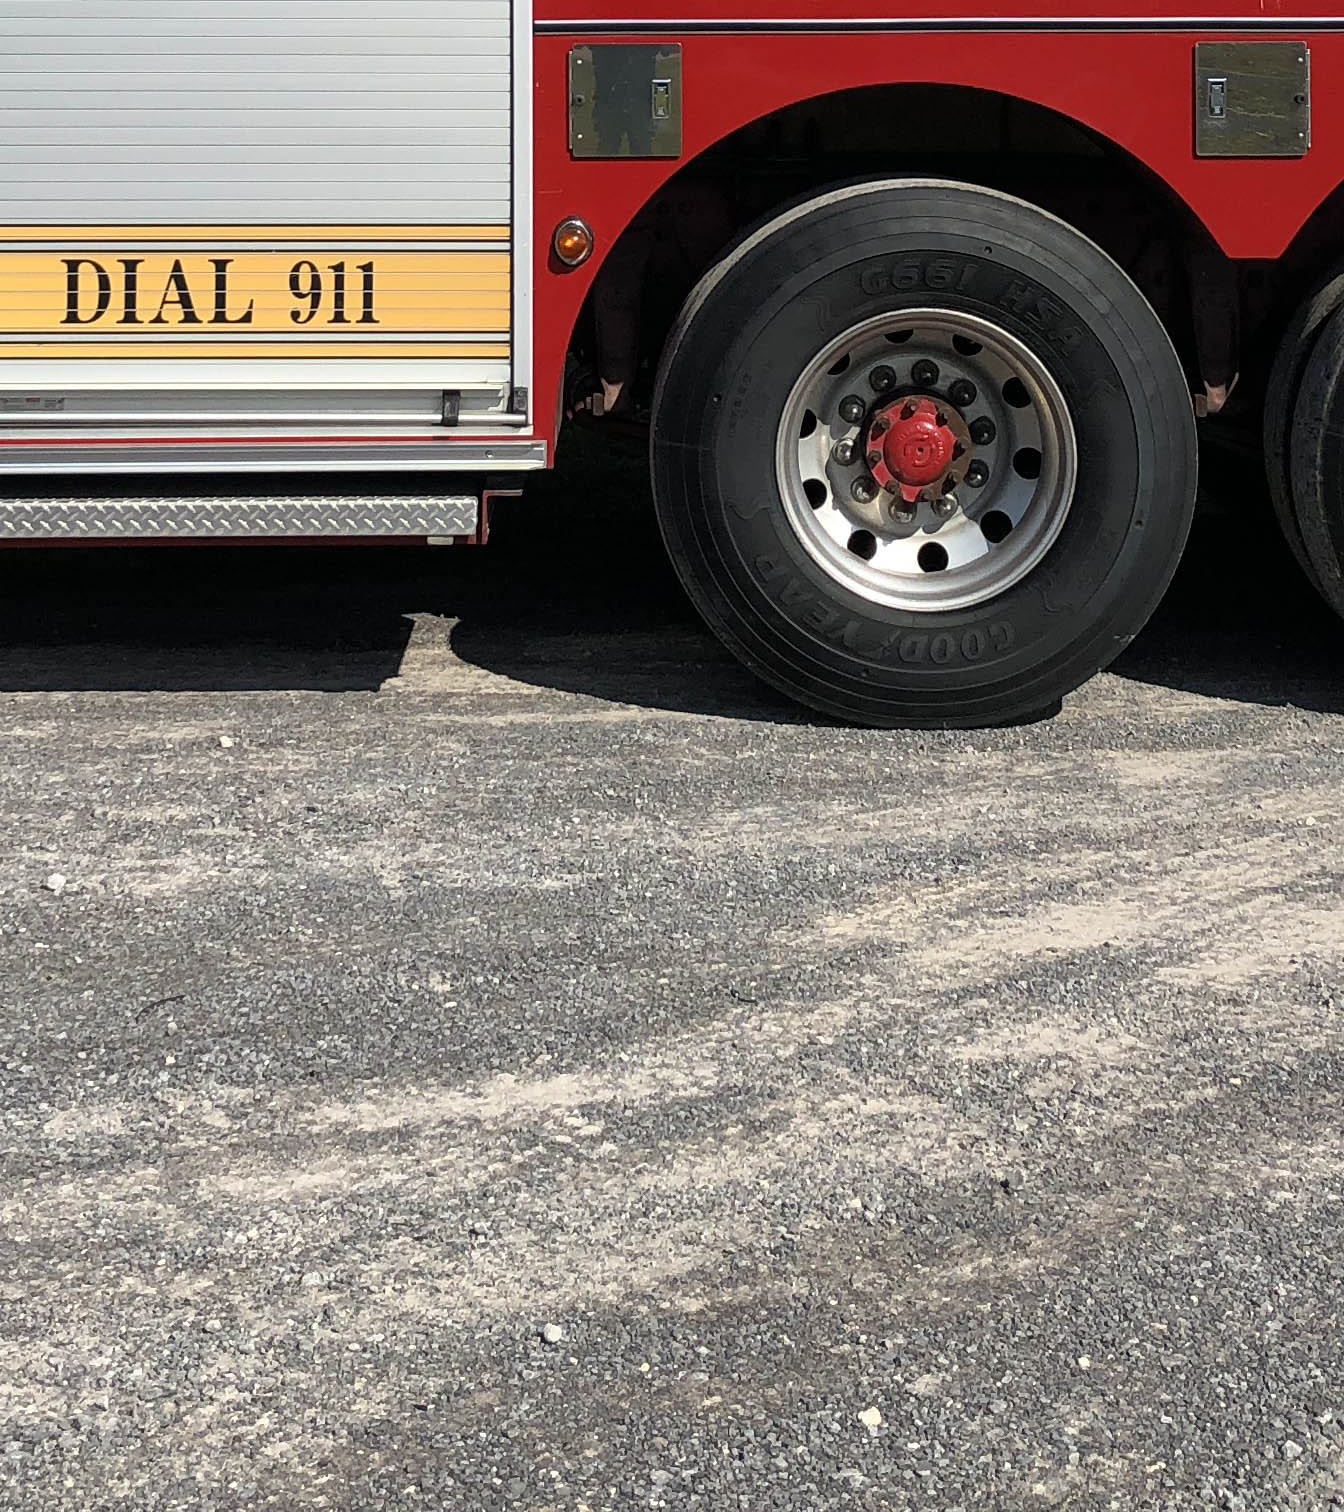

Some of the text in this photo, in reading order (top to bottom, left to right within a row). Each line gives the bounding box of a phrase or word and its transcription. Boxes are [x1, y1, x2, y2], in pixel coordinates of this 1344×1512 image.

[59, 259, 380, 324] DIAL 911
[860, 257, 976, 296] G661
